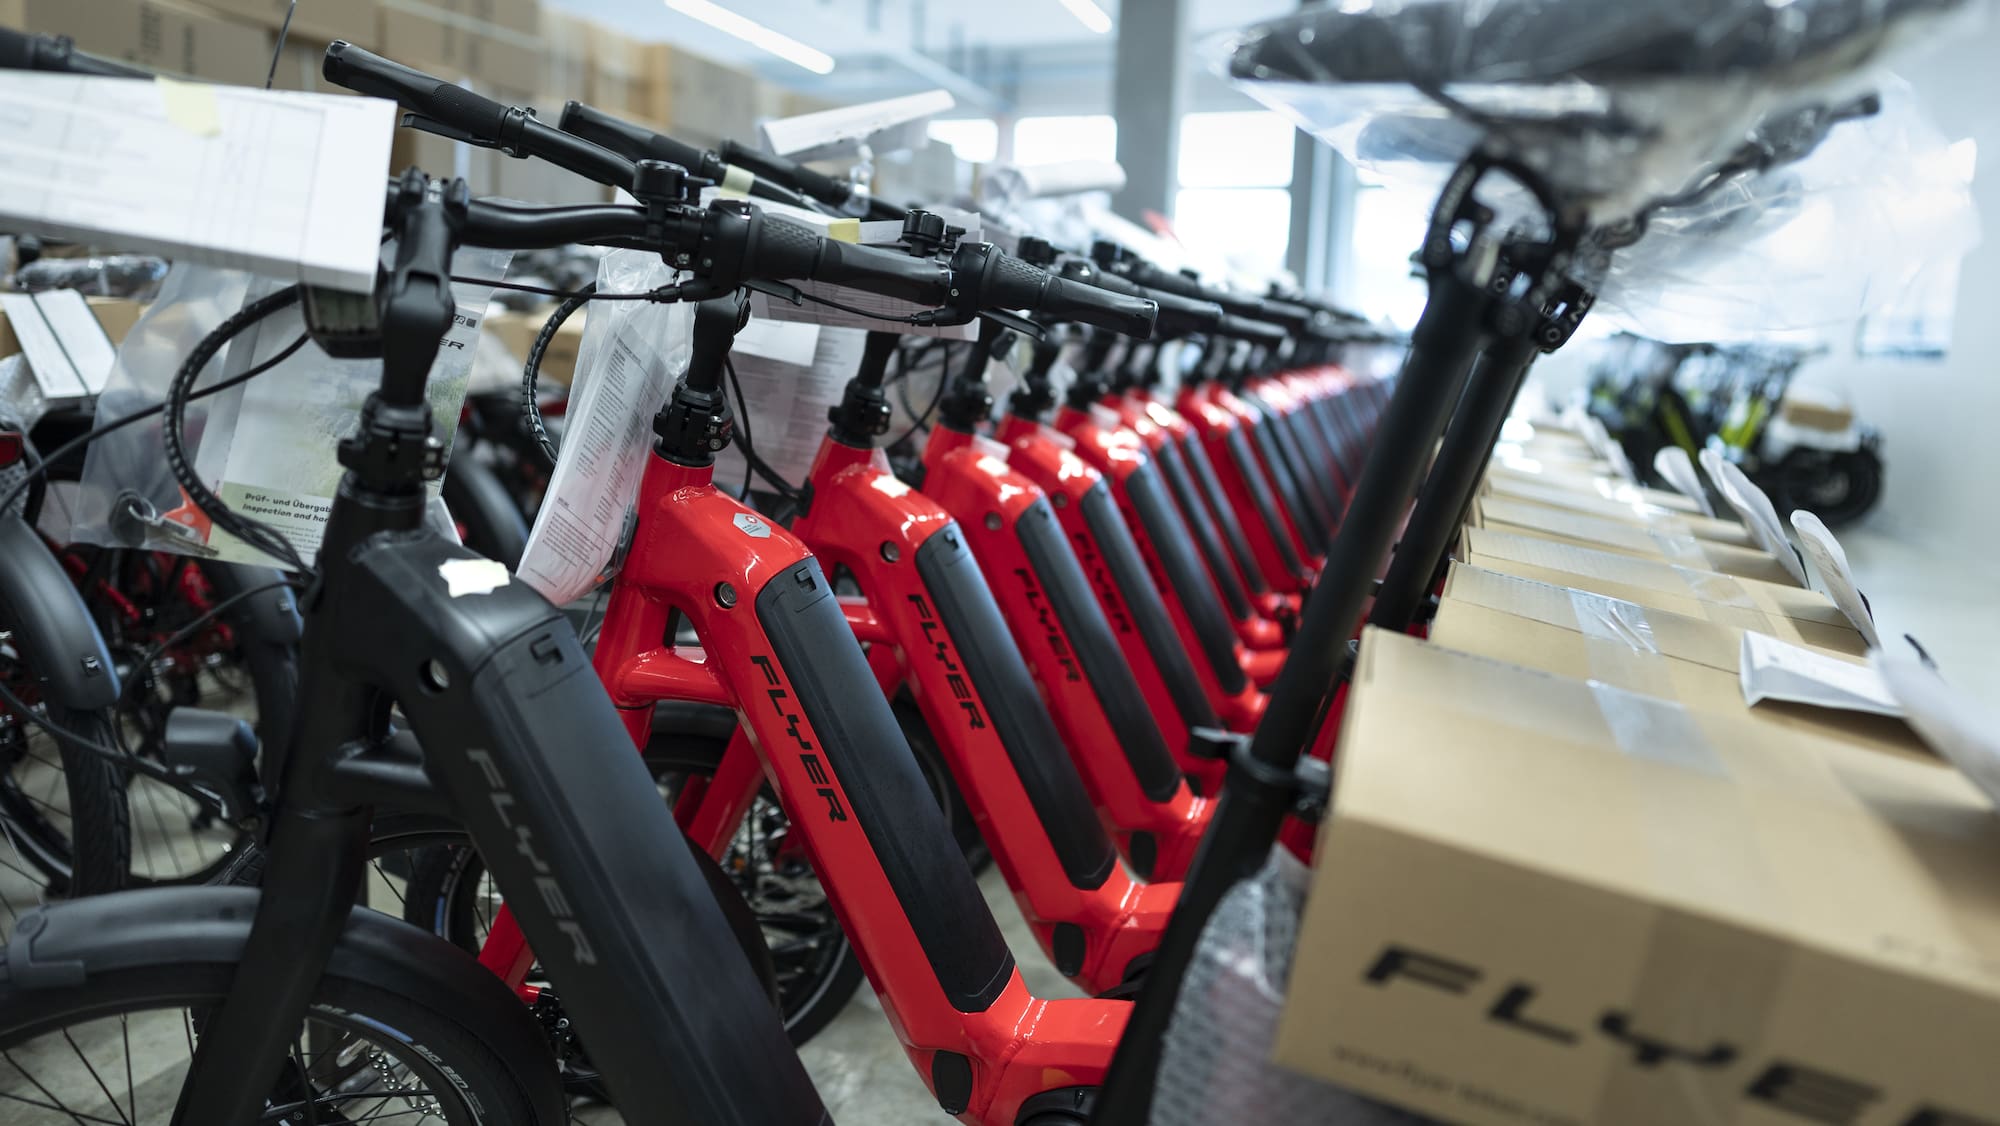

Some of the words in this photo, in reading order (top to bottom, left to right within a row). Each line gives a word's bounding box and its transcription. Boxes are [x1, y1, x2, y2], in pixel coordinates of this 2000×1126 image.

[242, 504, 291, 517] Inspection
[293, 511, 311, 520] and
[245, 493, 270, 503] Prüf-
[273, 498, 290, 506] und
[293, 499, 331, 513] Übergab
[907, 594, 986, 730] FLYER
[1014, 568, 1081, 682] FLYER
[750, 655, 847, 823] FLYER
[467, 749, 597, 966] FLYER
